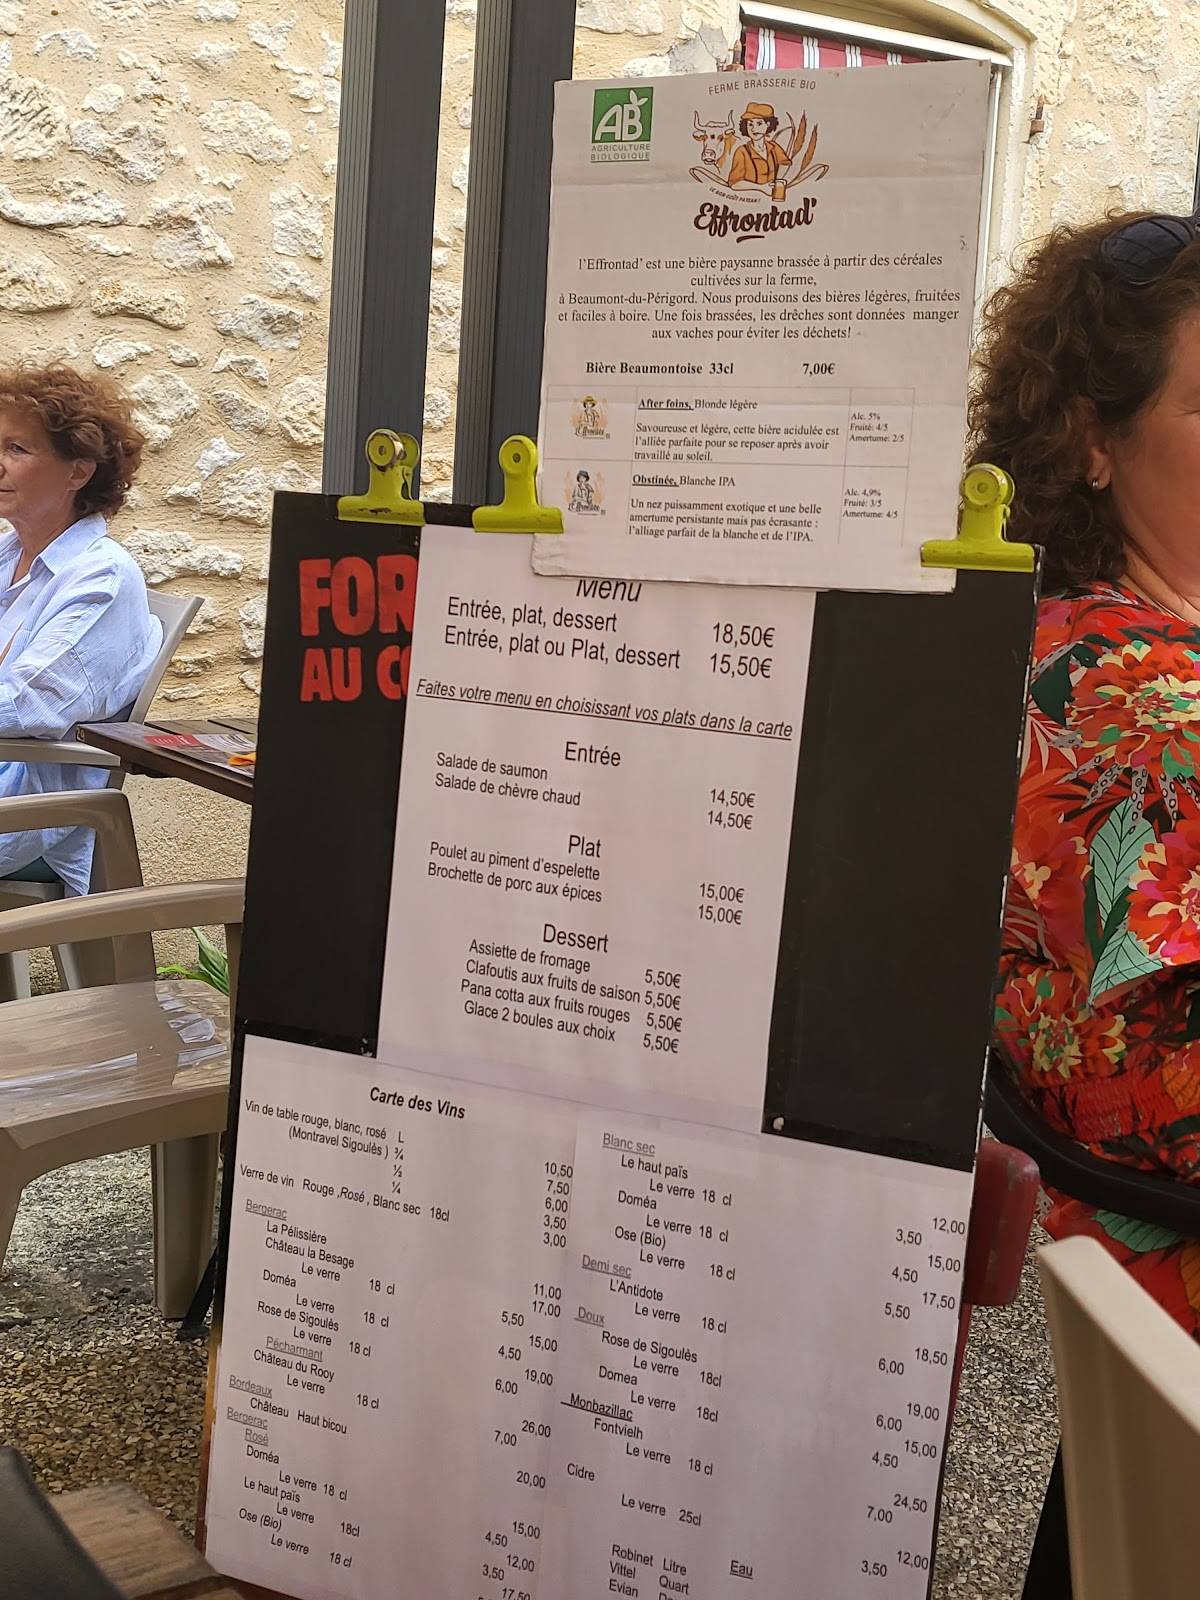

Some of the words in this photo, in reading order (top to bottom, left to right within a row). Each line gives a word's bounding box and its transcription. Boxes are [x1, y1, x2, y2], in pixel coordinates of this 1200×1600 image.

[708, 81, 740, 95] FERME
[743, 78, 796, 90] BRASSERIE
[800, 80, 816, 90] BIO
[594, 103, 643, 141] AB
[590, 152, 650, 161] BIOLOGIQUE
[591, 143, 650, 152] AGRICULTURE
[645, 259, 661, 270] est
[665, 260, 685, 269] une
[688, 256, 717, 269] bière
[718, 257, 774, 272] paysanne
[777, 255, 820, 270] brassée
[823, 254, 830, 267] à
[833, 254, 867, 270] partir
[869, 254, 890, 266] des
[893, 253, 942, 266] céréales
[690, 272, 743, 290] cultivées
[744, 276, 763, 286] sur
[766, 273, 776, 286] la
[780, 272, 817, 288] ferme,
[559, 293, 565, 304] à
[569, 291, 698, 307] Beaumont-du-Périgord.
[701, 291, 732, 304] Nous
[735, 290, 801, 307] produisons
[802, 290, 822, 303] des
[825, 290, 861, 303] bières
[864, 289, 910, 306] légères,
[914, 289, 960, 302] fruitées
[652, 329, 672, 339] aux
[675, 326, 714, 339] vaches
[716, 329, 744, 342] pour
[746, 326, 780, 339] éviter
[783, 326, 799, 339] les
[802, 325, 851, 339] déchets!
[586, 362, 616, 373] Bière
[620, 362, 703, 374] Beaumontoise
[709, 362, 734, 374] 33cl
[803, 363, 835, 376] 7,00€
[637, 398, 662, 411] After
[661, 398, 694, 411] foins,
[693, 399, 727, 411] Blonde
[729, 399, 758, 412] légère
[636, 422, 688, 433] Savoureuse
[689, 425, 698, 434] et
[700, 423, 731, 436] légère,
[733, 425, 756, 435] cette
[758, 424, 781, 435] bière
[783, 425, 823, 436] acidulée
[825, 427, 839, 436] est
[632, 474, 680, 488] Obstinée,
[679, 475, 716, 486] Blanche
[719, 476, 735, 487] IPA
[631, 498, 644, 509] Un
[646, 501, 663, 510] nez
[664, 499, 723, 512] puissamment
[725, 502, 766, 515] exotique
[767, 504, 776, 513] et
[779, 505, 796, 514] une
[798, 503, 822, 514] belle
[576, 579, 642, 602] Menu
[448, 596, 505, 624] Entrée,
[512, 603, 546, 628] plat,
[553, 607, 617, 633] dessert
[713, 622, 775, 648] 18,50€
[445, 625, 502, 653] Entrée,
[509, 632, 540, 656] plat
[544, 640, 565, 656] ou
[571, 638, 608, 664] Plat,
[615, 643, 680, 669] dessert
[710, 653, 773, 679] 15,50€
[300, 647, 362, 702] AU
[416, 679, 456, 700] Faites
[459, 686, 492, 703] votre
[495, 693, 532, 708] menu
[535, 697, 552, 710] en
[555, 696, 631, 720] choisissant
[635, 708, 659, 722] vos
[661, 708, 696, 728] plats
[700, 712, 735, 731] dans
[739, 716, 752, 734] la
[756, 722, 792, 738] carte
[565, 741, 621, 767] Entrée
[436, 752, 479, 771] Salade
[481, 758, 497, 774] de
[499, 764, 548, 781] saumon
[710, 788, 756, 808] 14,50€
[435, 772, 477, 792] Salade
[479, 778, 495, 794] de
[498, 781, 539, 800] chèvre
[542, 788, 581, 806] chaud
[708, 810, 753, 830] 14,50€
[568, 834, 601, 858] Plat
[430, 841, 467, 861] Poulet
[470, 851, 485, 863] au
[488, 851, 530, 871] piment
[532, 857, 600, 881] d'espelette
[700, 882, 745, 903] 15,00€
[543, 923, 608, 953] Dessert
[469, 939, 517, 960] Assiette
[520, 948, 536, 963] de
[539, 950, 591, 975] fromage
[644, 969, 682, 989] 5,50€
[465, 959, 518, 982] Clafoutis
[521, 972, 544, 986] aux
[547, 972, 578, 992] fruits
[581, 979, 596, 995] de
[599, 985, 640, 1003] saison
[644, 990, 681, 1011] 5,50€
[370, 1087, 404, 1107] Carte
[408, 1095, 433, 1112] des
[438, 1099, 465, 1119] Vins
[245, 1099, 260, 1113] Vin
[262, 1104, 274, 1116] de
[276, 1106, 299, 1122] table
[301, 1114, 331, 1130] rouge,
[334, 1117, 363, 1137] blanc,
[365, 1127, 387, 1140] rosé
[398, 1131, 404, 1144] L
[603, 1133, 633, 1153] Blanc
[635, 1140, 656, 1155] sec
[545, 1162, 573, 1179] 10,50
[621, 1154, 635, 1169] Le
[637, 1157, 662, 1175] haut
[664, 1165, 688, 1180] païs
[547, 1179, 572, 1196] 7,50
[245, 1199, 288, 1221] Bergerac
[267, 1220, 278, 1234] La
[280, 1223, 327, 1245] Pélissière
[933, 1217, 966, 1236] 12,00
[265, 1236, 305, 1256] Château
[307, 1245, 316, 1259] la
[318, 1248, 354, 1270] Besage
[534, 1283, 562, 1301] 11,00
[610, 1278, 663, 1302] L'Antidote
[532, 1300, 561, 1318] 17,00
[570, 1393, 633, 1421] Monbazillac
[521, 1419, 551, 1438] 26,00
[594, 1417, 643, 1440] Fontvielh
[567, 1463, 595, 1481] Cidre
[893, 1493, 928, 1513] 24,50
[611, 1544, 654, 1567] Robinet
[663, 1557, 687, 1576] Litre
[729, 1560, 753, 1580] Eau
[609, 1579, 639, 1598] Evian
[610, 1561, 636, 1582] Vittel
[659, 1574, 689, 1596] Quart
